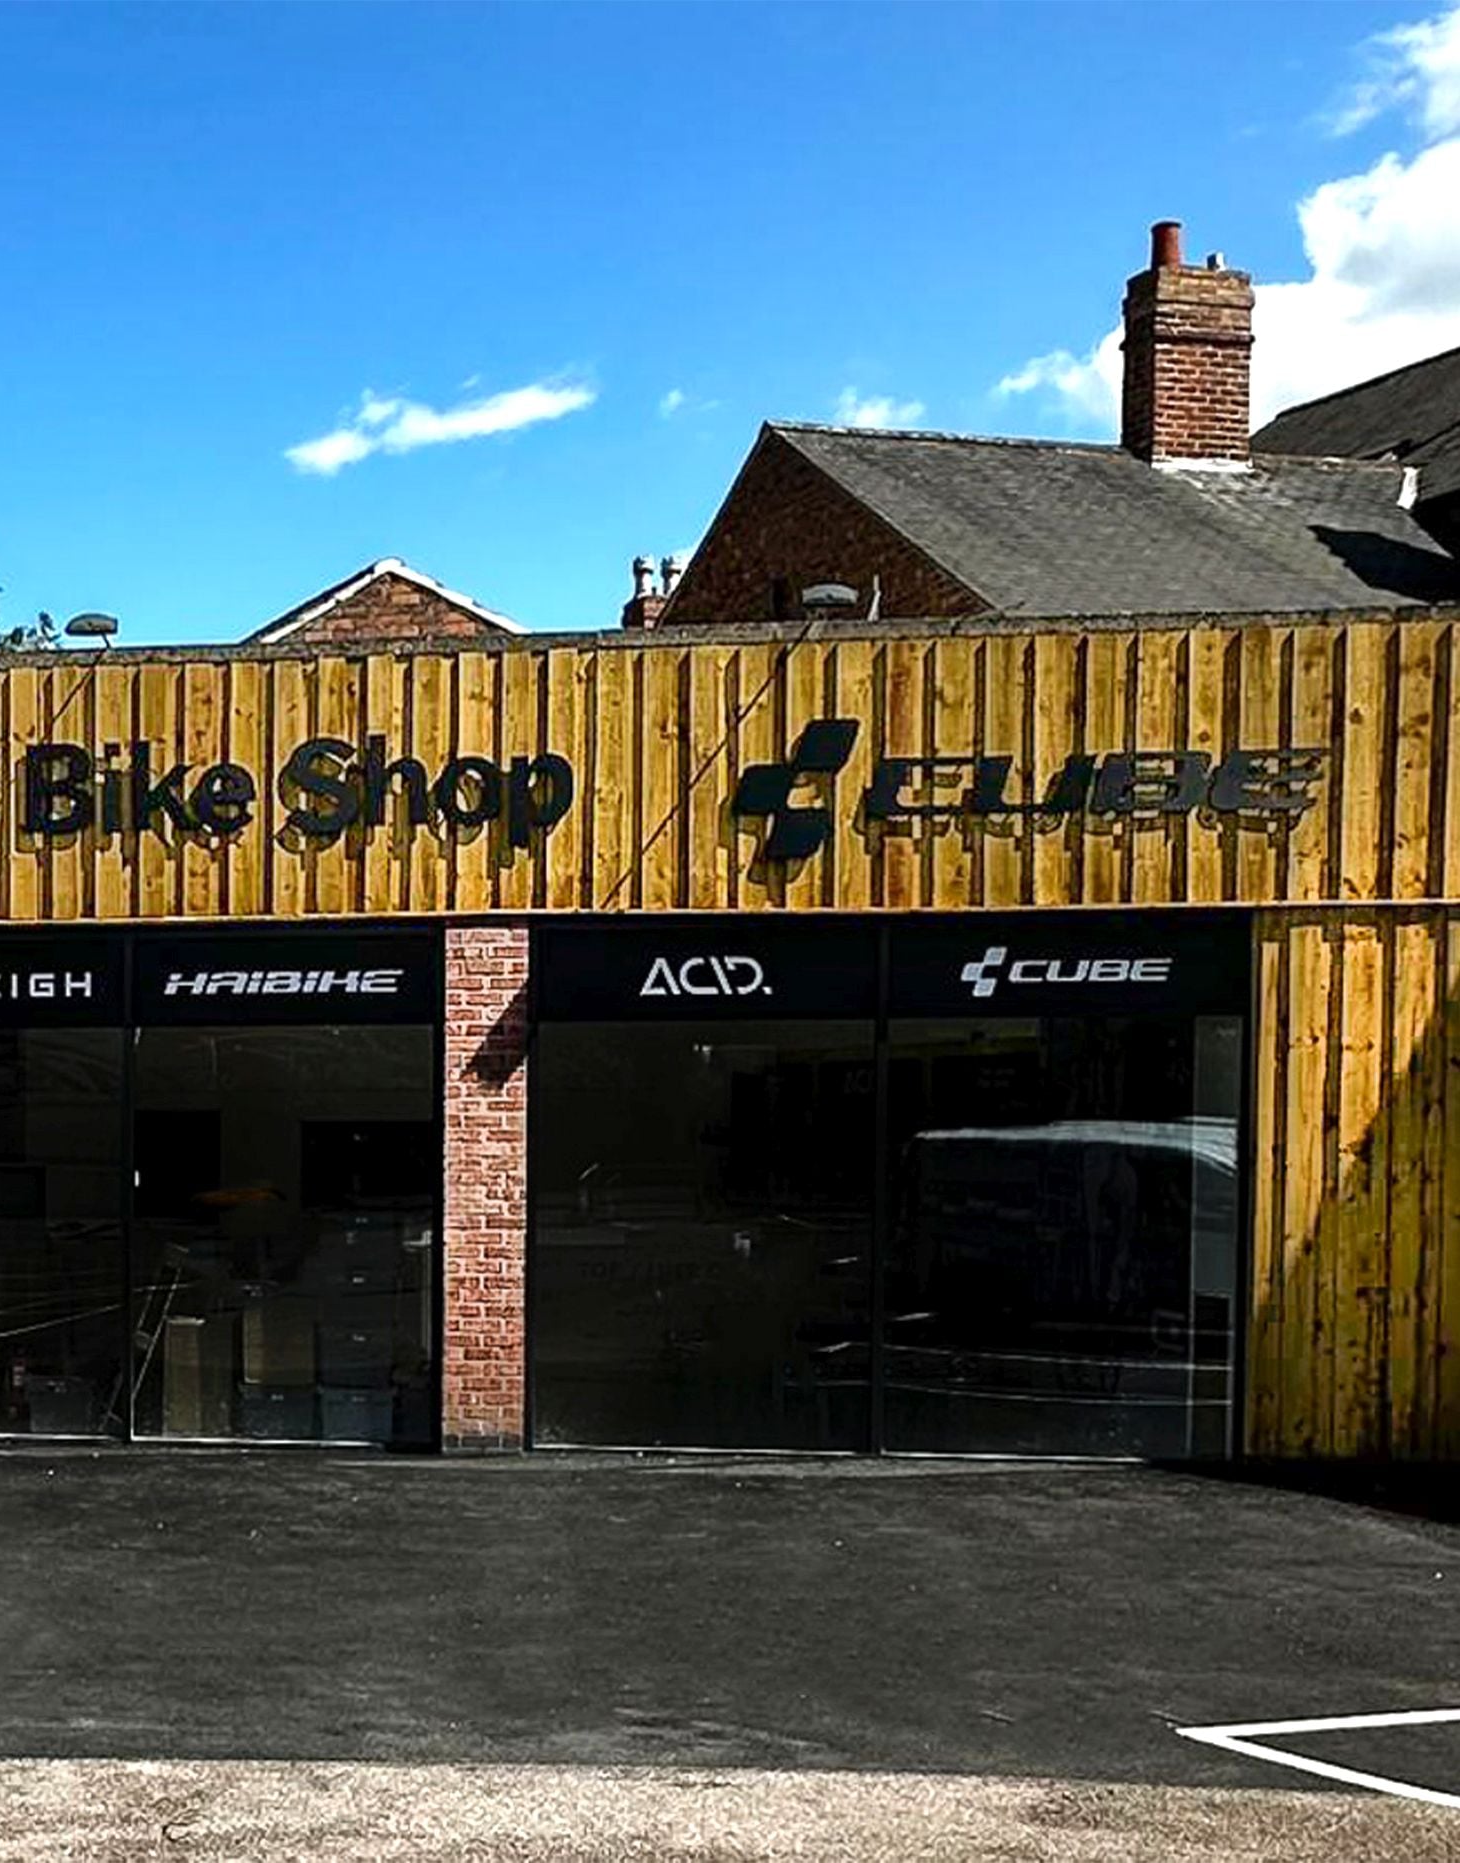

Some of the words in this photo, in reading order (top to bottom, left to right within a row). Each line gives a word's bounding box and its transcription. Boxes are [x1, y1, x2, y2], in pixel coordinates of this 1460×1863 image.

[22, 742, 256, 836] Bike
[282, 734, 574, 847] Shop
[865, 747, 1330, 816] CUBE
[163, 969, 404, 995] HAIBIKE
[1007, 956, 1173, 983] CUBE
